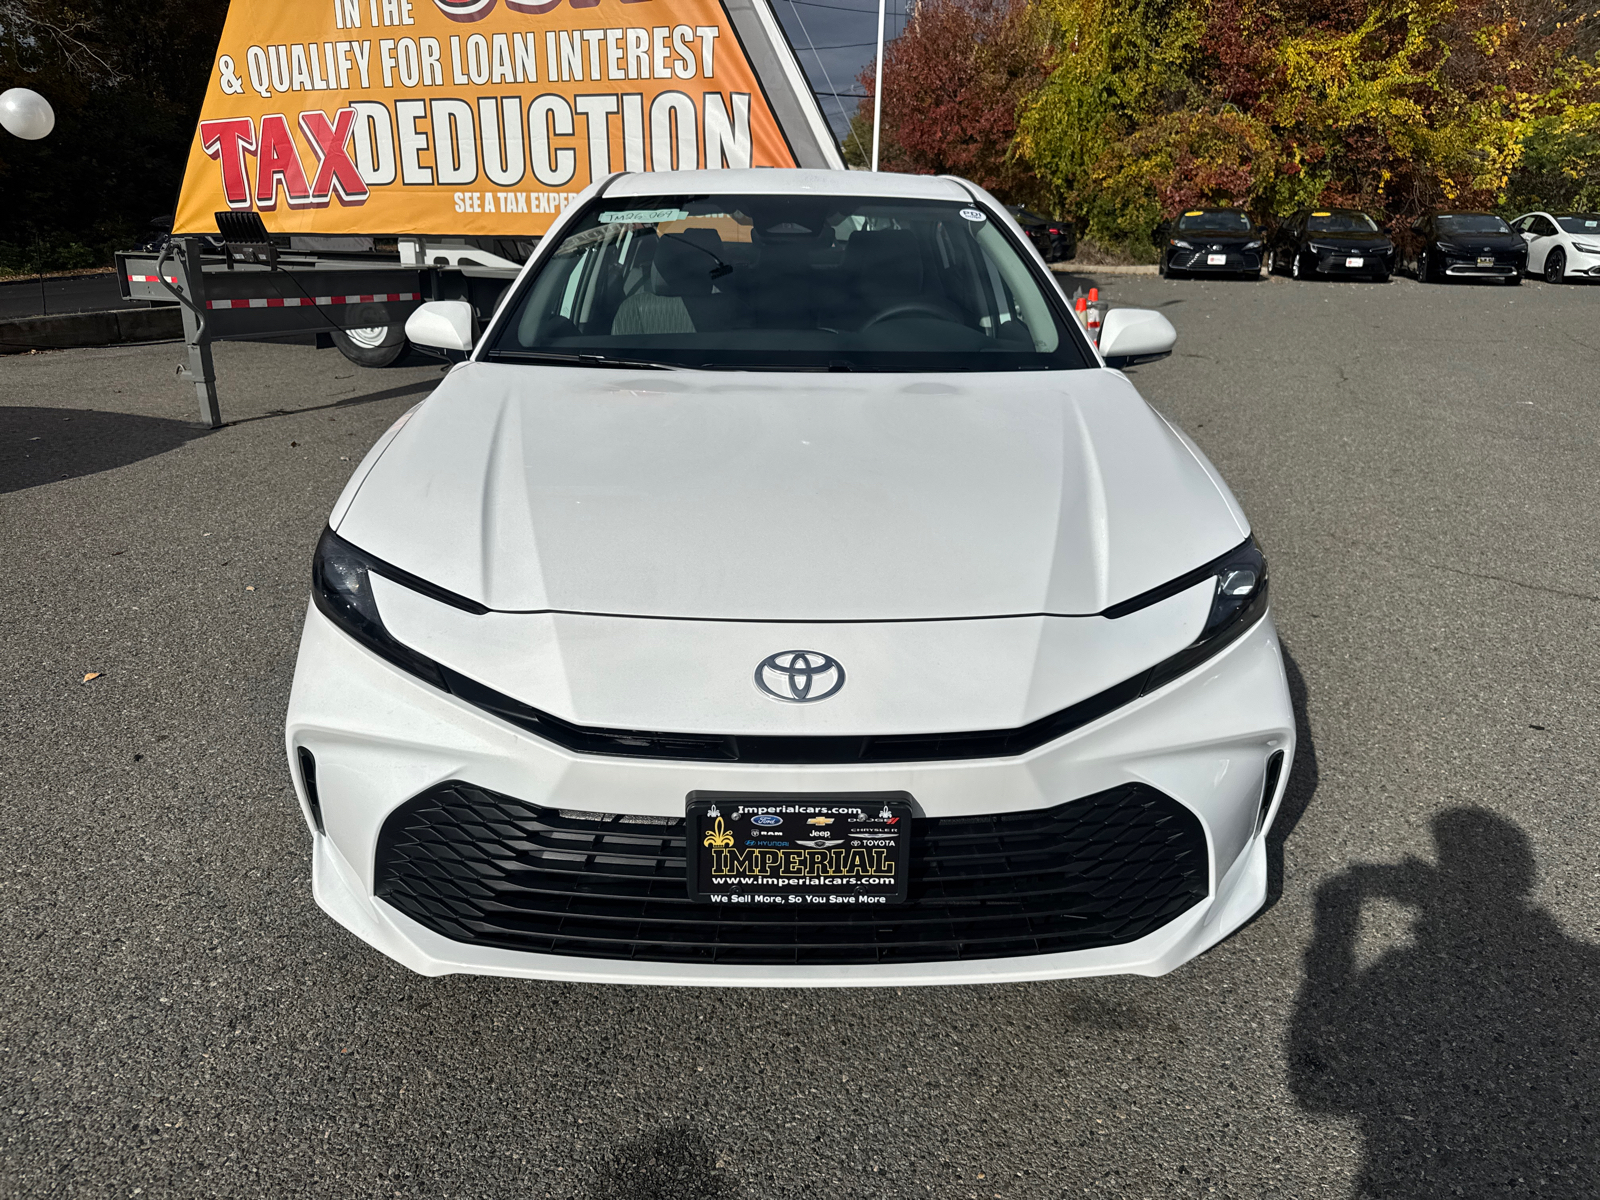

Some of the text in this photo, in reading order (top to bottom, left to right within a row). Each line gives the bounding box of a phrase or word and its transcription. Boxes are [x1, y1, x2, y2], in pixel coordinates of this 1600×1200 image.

[334, 0, 361, 29] IN
[218, 24, 719, 98] & QUALIFY FOR LOAN INTEREST
[200, 90, 775, 212] TAX DEDUCTION
[454, 192, 481, 213] SEE
[484, 192, 496, 213] A
[497, 192, 528, 213] TAX
[738, 805, 862, 814] Imperialcars.com
[711, 848, 895, 876] IMPERIAL
[711, 876, 895, 887] www.imperialcars.com
[710, 895, 886, 904] We Sell More, So You Save More
